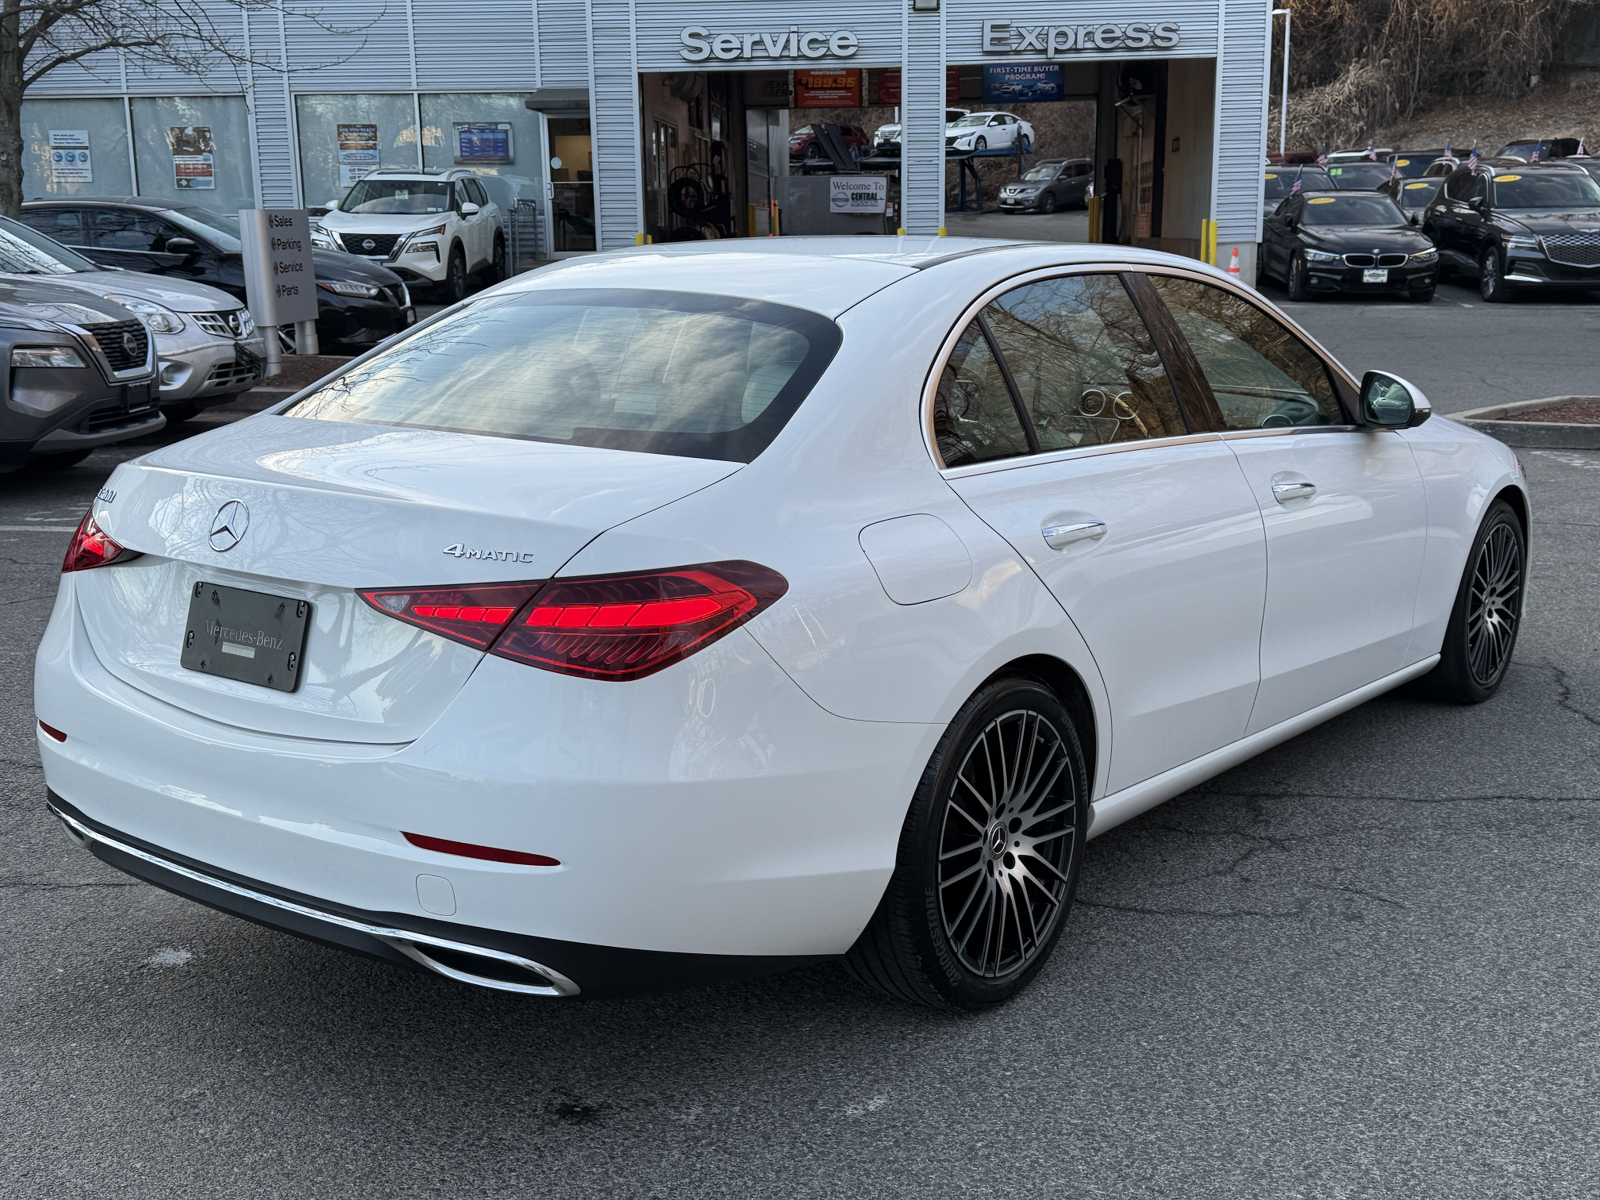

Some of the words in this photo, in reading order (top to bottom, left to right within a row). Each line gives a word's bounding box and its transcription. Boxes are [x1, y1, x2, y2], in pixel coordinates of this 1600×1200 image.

[679, 25, 860, 61] Service
[982, 18, 1180, 59] Express
[770, 80, 788, 88] EXP
[801, 77, 856, 88] $189.95
[833, 182, 871, 190] Welcome
[873, 181, 884, 191] To
[851, 192, 877, 200] CENTRAL
[274, 215, 292, 227] Sales
[277, 239, 301, 252] Parking
[279, 261, 303, 274] Service
[282, 285, 298, 296] Parts
[443, 543, 534, 564] 4MATIC
[205, 619, 283, 650] Mercedes-Benz
[924, 886, 963, 987] BRIDGESTONE
